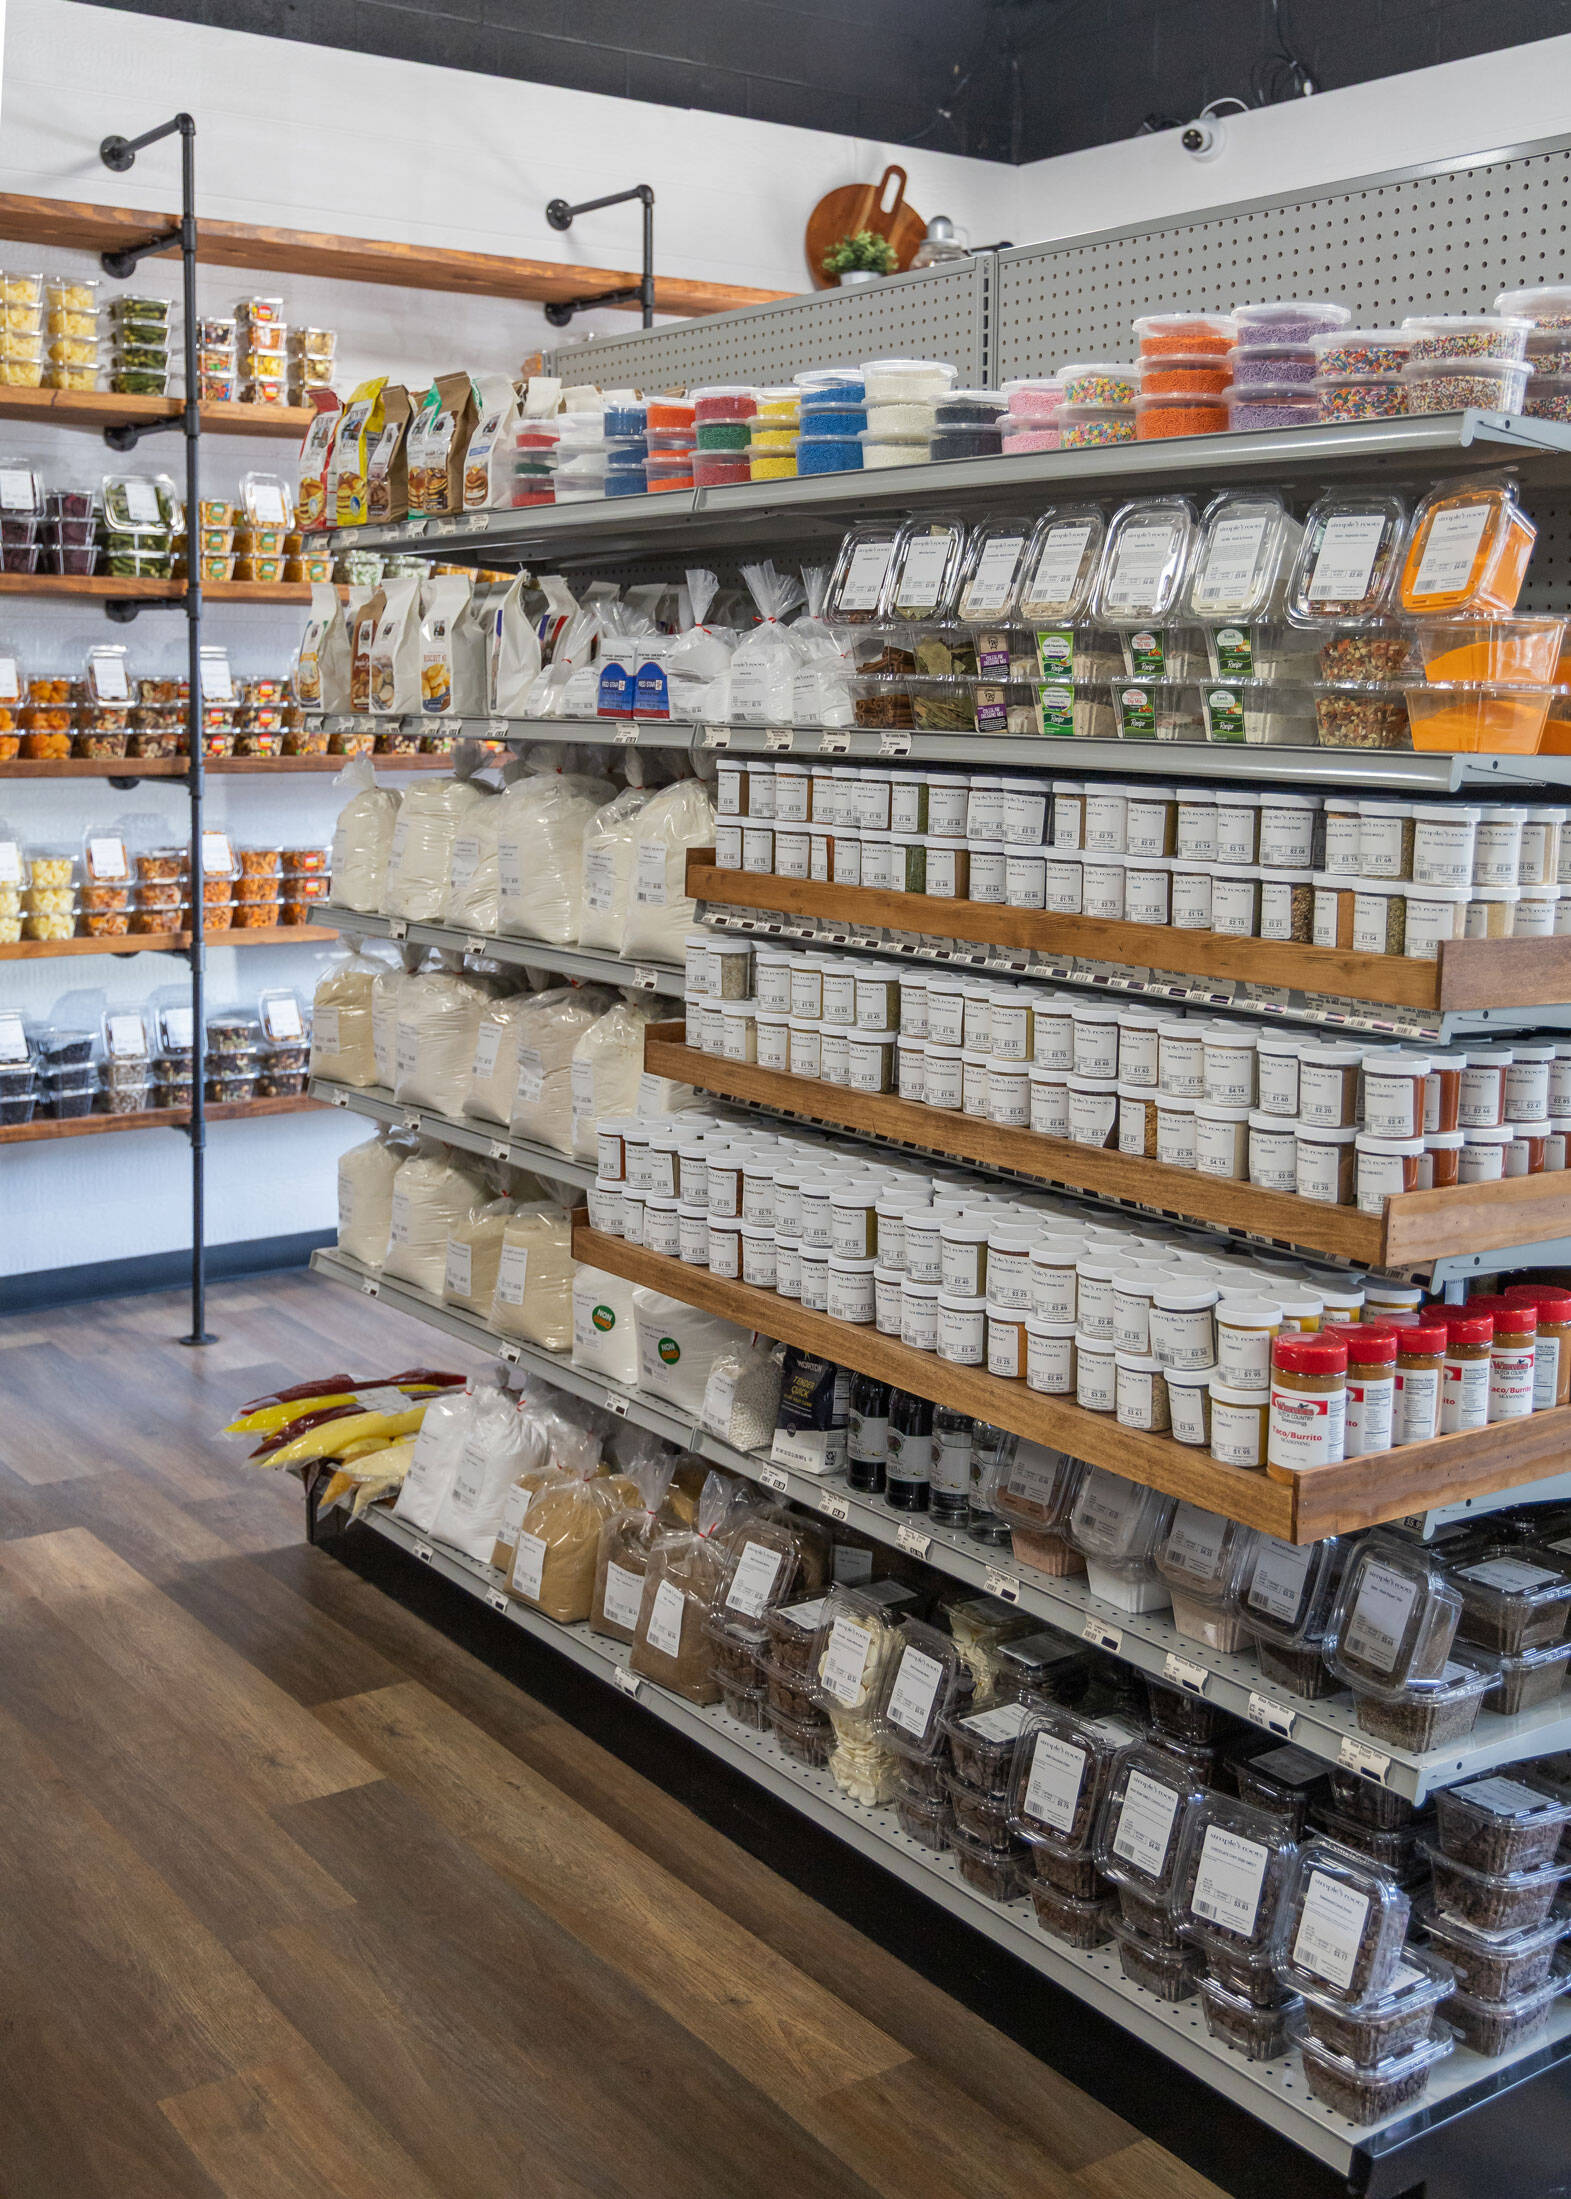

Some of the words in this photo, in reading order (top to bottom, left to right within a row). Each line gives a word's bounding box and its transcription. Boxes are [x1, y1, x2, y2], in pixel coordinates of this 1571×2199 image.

[597, 1309, 612, 1321] NON
[661, 1343, 675, 1351] NON
[793, 1375, 816, 1390] TENDER
[791, 1385, 810, 1399] QUICK
[1272, 1425, 1322, 1441] Taco/Burrito
